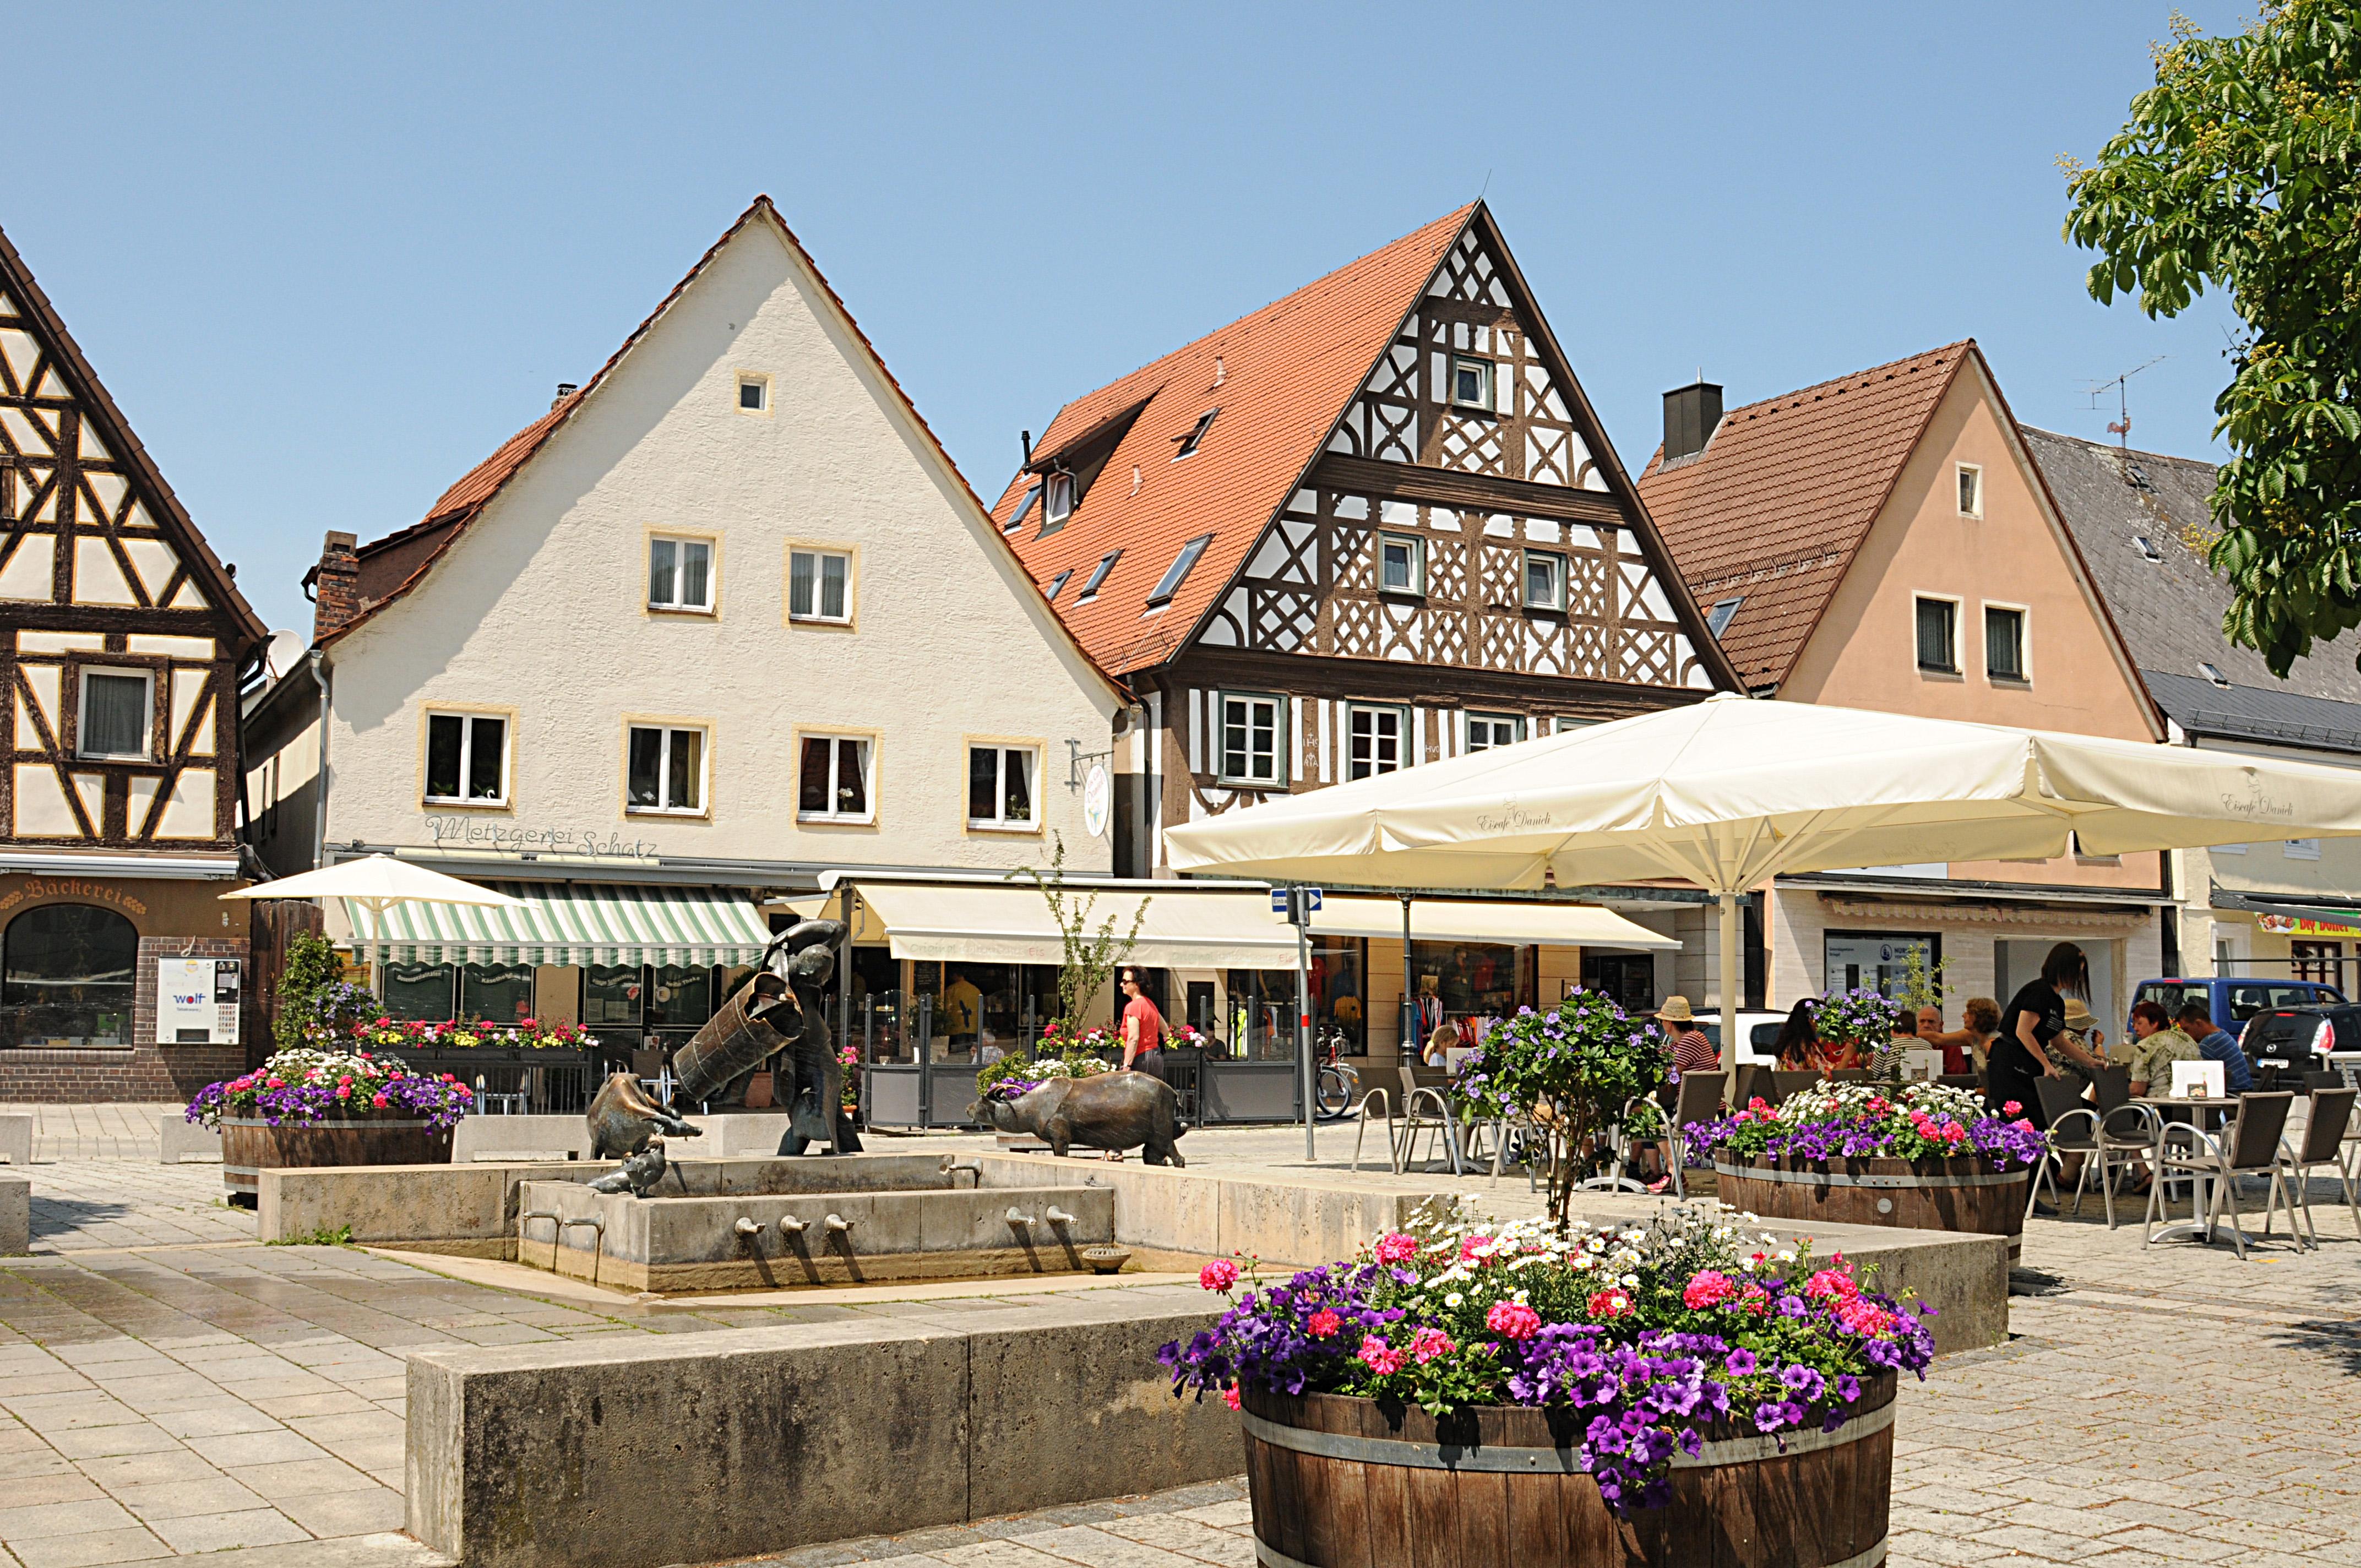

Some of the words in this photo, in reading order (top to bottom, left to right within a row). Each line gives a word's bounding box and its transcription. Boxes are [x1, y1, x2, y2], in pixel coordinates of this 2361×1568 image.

[2221, 793, 2257, 818] Eiscafé
[2259, 796, 2294, 816] Danieli
[1477, 815, 1511, 832] Eiscafé
[1514, 810, 1551, 827] Danieli
[425, 815, 574, 853] Metzgerei
[576, 831, 657, 857] Schatz
[25, 878, 123, 904] Bäckerei
[910, 942, 956, 957] Original
[1029, 946, 1045, 956] Eis
[1279, 954, 1293, 963] Eis
[173, 993, 206, 1004] wolf
